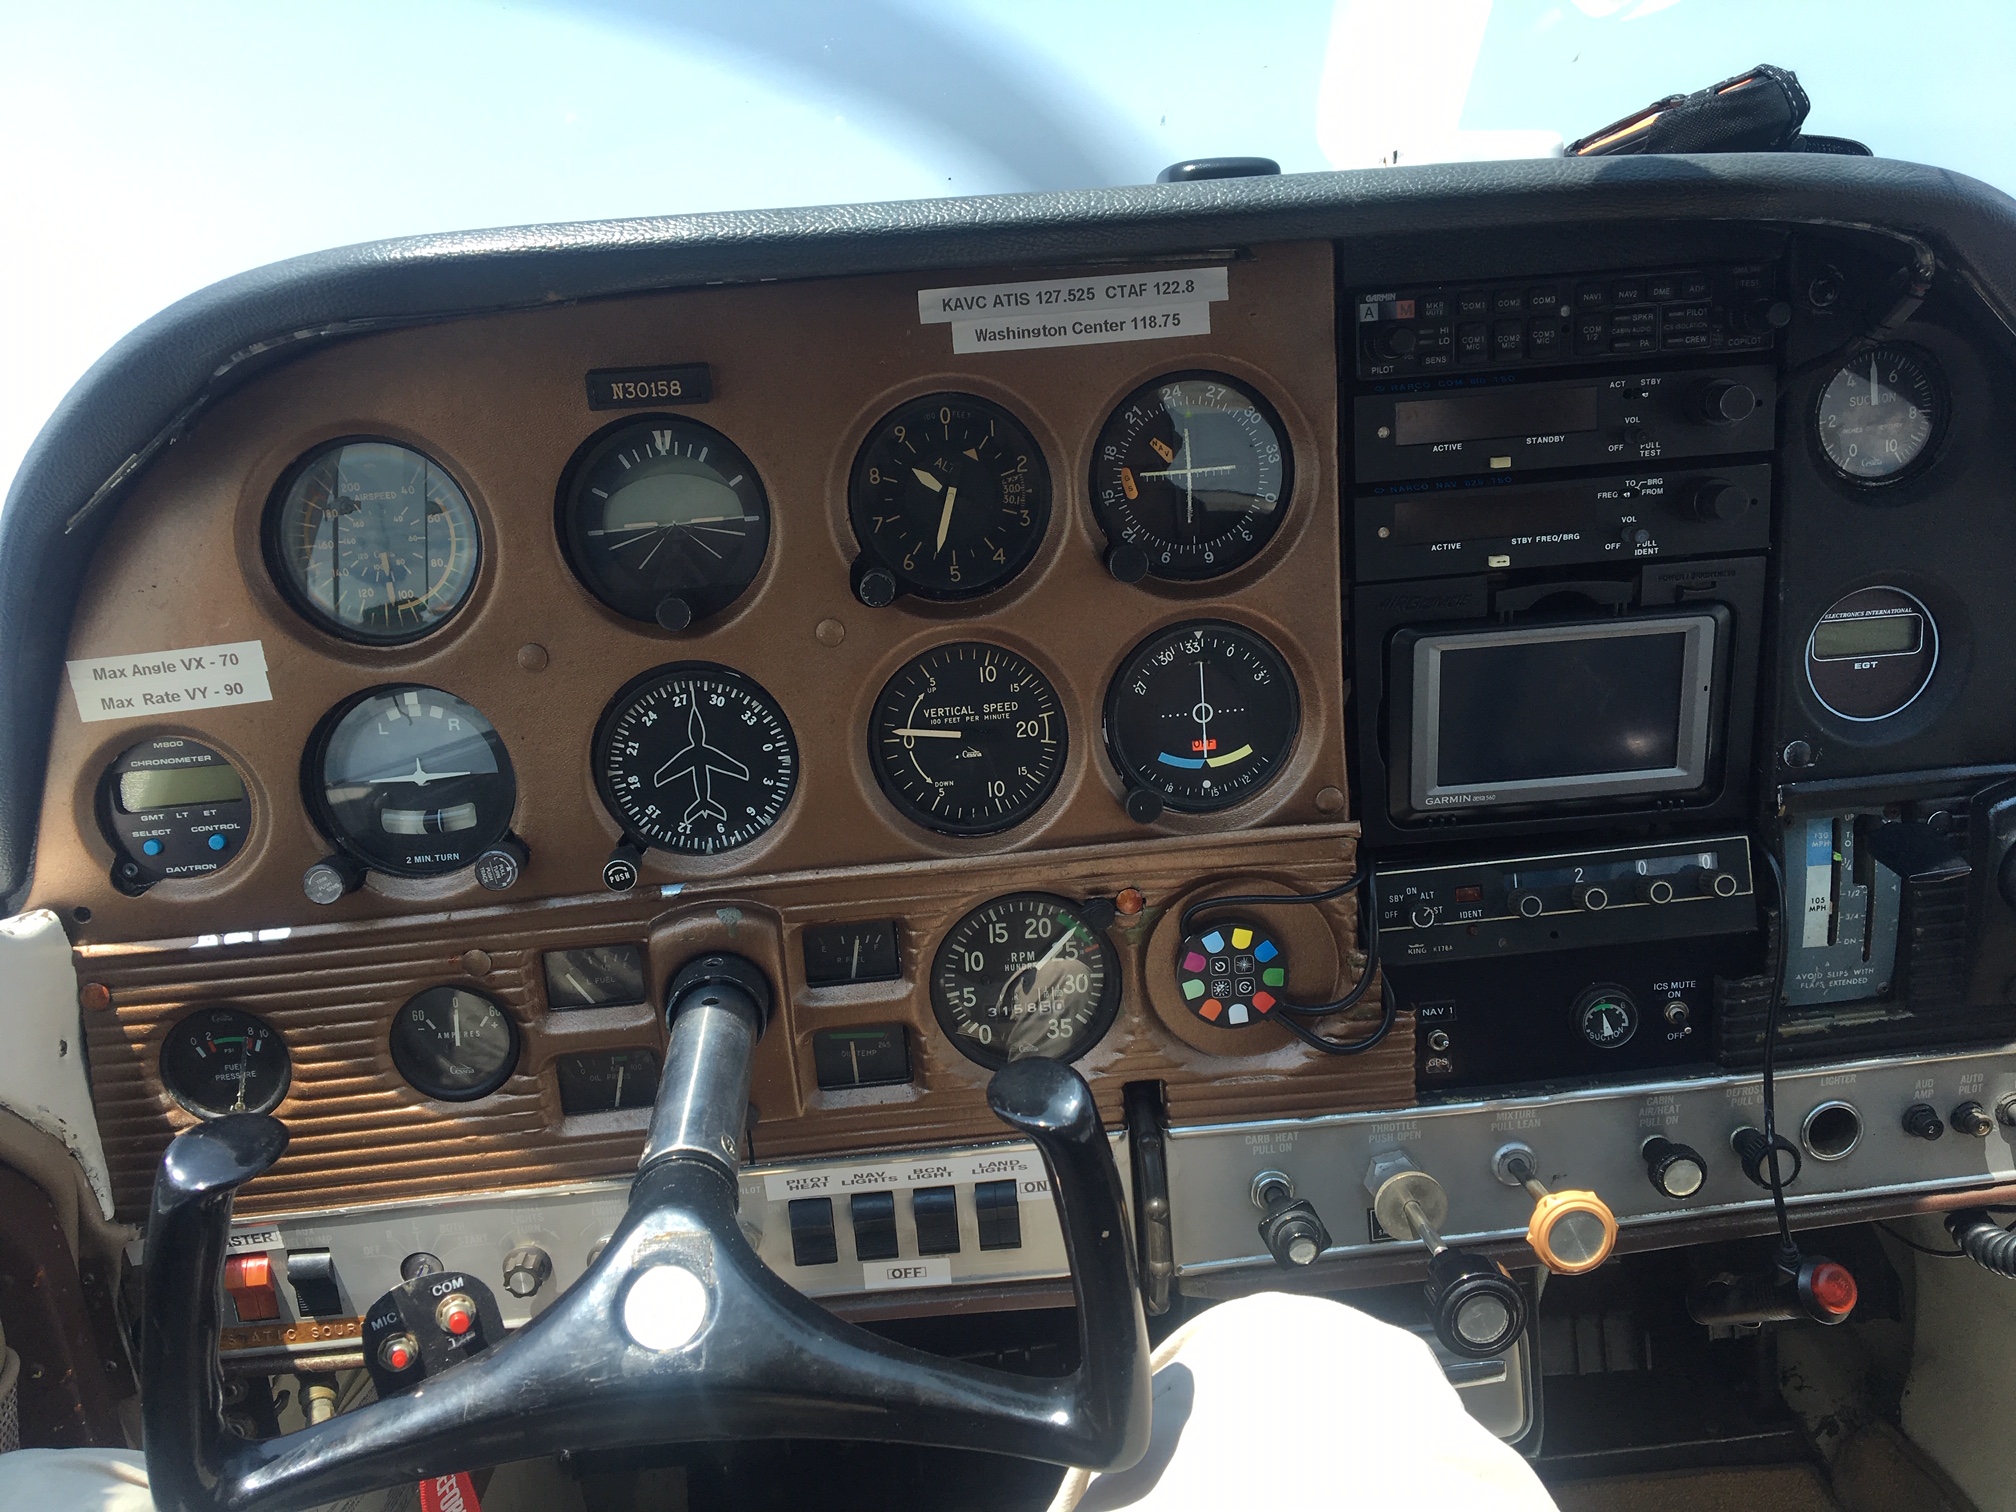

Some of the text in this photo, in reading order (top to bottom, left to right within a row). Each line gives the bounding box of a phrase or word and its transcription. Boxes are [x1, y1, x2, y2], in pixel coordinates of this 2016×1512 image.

[942, 280, 1195, 312] KAVC ATIS 127.525 CTAF 122.8
[1618, 291, 1638, 299] NAV2
[1654, 288, 1670, 296] DME
[1498, 299, 1521, 308] COM2
[1533, 296, 1556, 305] COM3
[1632, 313, 1654, 322] SPKR
[1686, 308, 1708, 316] PILOT
[974, 313, 1181, 342] Washington Center 118.75
[1498, 335, 1521, 343] COM2
[1426, 356, 1447, 365] SENS
[1372, 366, 1395, 375] PILOT
[1610, 380, 1626, 389] ACT
[1640, 378, 1662, 386] STBY
[611, 380, 682, 399] N30158
[1850, 393, 1897, 407] SUCION
[1624, 416, 1641, 424] VOL
[1526, 434, 1566, 445] STANDBY
[1432, 443, 1463, 452] ACTIVE
[1608, 444, 1624, 452] OFF
[1640, 450, 1661, 458] TEST
[870, 468, 881, 485] 8
[1648, 478, 1664, 486] BRG
[341, 484, 360, 493] 200
[1642, 488, 1664, 496] FROM
[354, 492, 397, 501] AIRSPEED
[1598, 491, 1619, 500] FREQ
[872, 517, 883, 534] 7
[1511, 532, 1581, 545] STBY FREQ/BRG
[1431, 542, 1462, 552] ACTIVE
[1604, 542, 1622, 551] OFF
[1634, 547, 1660, 557] IDENT
[993, 548, 1006, 565] 4
[1825, 608, 1913, 619] ELECTRONICS INTERNATIONAL
[1186, 642, 1201, 654] 33
[1160, 651, 1174, 666] 30
[92, 667, 128, 681] Max
[132, 660, 177, 677] Angle
[180, 656, 206, 672] VX
[219, 653, 239, 667] 70
[1854, 662, 1878, 670] EGT
[980, 666, 997, 683] 10
[100, 696, 135, 711] Max
[142, 690, 181, 706] Rate
[184, 686, 209, 701] VY
[224, 682, 244, 697] 90
[673, 694, 687, 707] 27
[710, 694, 726, 707] 30
[924, 702, 1019, 718] VERTICAL SPEED
[642, 710, 658, 727] 24
[741, 710, 757, 726] 33
[984, 713, 1010, 721] MINUTE
[448, 718, 460, 731] R
[1016, 720, 1039, 738] 20
[626, 740, 639, 756] 21
[130, 755, 212, 768] CHRONOMETER
[1426, 794, 1471, 805] GARMIN
[141, 814, 165, 823] GMT
[176, 812, 189, 820] LT
[204, 809, 217, 817] ET
[132, 828, 172, 838] SELECT
[191, 824, 241, 833] CONTROL
[1812, 840, 1830, 848] MPH
[406, 853, 460, 864] 2 MIN. TURN
[166, 864, 217, 874] DAVTRON
[610, 871, 631, 884] PUSH
[1406, 887, 1417, 895] ON
[1420, 890, 1435, 900] ALT
[1389, 894, 1404, 904] SBY
[1808, 904, 1827, 913] MPH
[1384, 910, 1398, 919] OFF
[1460, 910, 1483, 919] IDENT
[988, 923, 1008, 944] 15
[1024, 918, 1051, 939] 20
[964, 952, 984, 972] 10
[1011, 951, 1035, 963] RPM
[1796, 968, 1874, 980] AVOID SLIPS WITH
[1063, 974, 1089, 994] 30
[1653, 980, 1696, 991] ICS MUTE
[1829, 978, 1868, 987] EXTENDED
[1667, 990, 1681, 999] ON
[412, 1010, 425, 1021] 60
[1422, 1006, 1454, 1016] NAV 1
[1047, 1019, 1073, 1039] 35
[1667, 1032, 1685, 1041] OFF
[1428, 1058, 1448, 1068] GPS
[1820, 1074, 1857, 1087] LIGHTER
[1915, 1078, 1934, 1089] AUD
[1960, 1072, 1984, 1084] AUTO
[1726, 1083, 1776, 1098] DEFROSTR
[1914, 1088, 1934, 1100] AMP
[1958, 1083, 1983, 1095] PILOT
[1646, 1094, 1675, 1106] CABIN
[1731, 1096, 1754, 1107] PULL
[1496, 1109, 1538, 1122] MIXTURE
[1638, 1104, 1681, 1118] AIR/HEAT
[1371, 1120, 1418, 1133] THROTTLE
[1491, 1118, 1541, 1133] PULL LEAN
[1639, 1114, 1679, 1128] PULL ON
[1245, 1132, 1299, 1146] CARB HEAT
[1368, 1130, 1422, 1144] PUSH OPEN
[1253, 1143, 1292, 1155] PULL ON
[972, 1164, 1028, 1175] LIGHTS
[978, 1159, 1021, 1169] LAND
[853, 1171, 886, 1180] NAV
[907, 1170, 954, 1181] LIGHT
[913, 1166, 947, 1175] BCN
[786, 1176, 831, 1187] PITOT
[842, 1176, 899, 1186] LIGHTS
[789, 1182, 830, 1192] HEAT
[1024, 1182, 1048, 1193] ON
[229, 1232, 273, 1248] STER
[891, 1268, 922, 1279] OFF
[432, 1277, 464, 1297] COM
[371, 1312, 397, 1332] MIC
